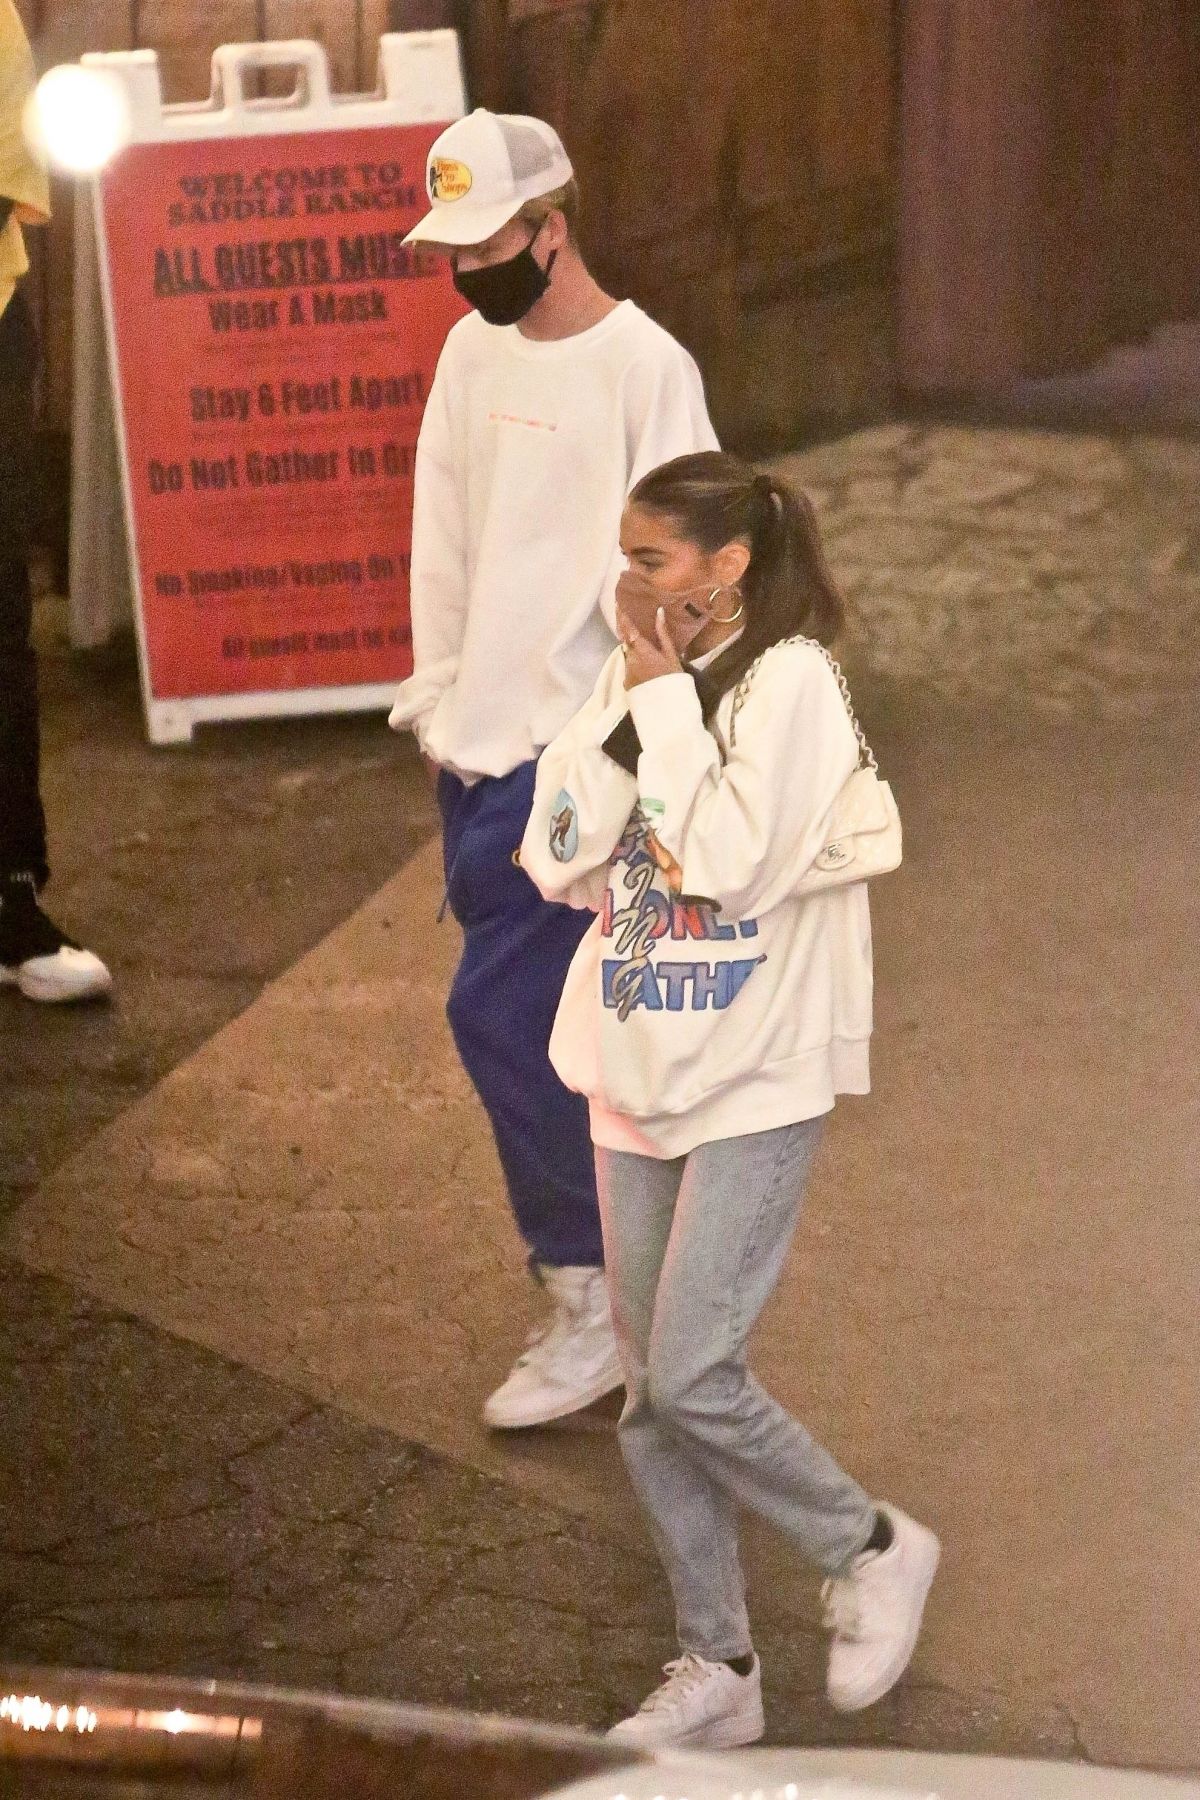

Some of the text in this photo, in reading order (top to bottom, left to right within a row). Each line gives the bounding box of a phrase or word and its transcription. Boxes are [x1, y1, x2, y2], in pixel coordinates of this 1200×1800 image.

[179, 160, 402, 197] WELCOME TO
[168, 186, 417, 227] SADDLE RANCH
[155, 244, 213, 296] ALL
[209, 288, 388, 332] Wear A Mask
[190, 369, 425, 422] Stay 6 Feet Apart
[148, 458, 183, 495] Do
[190, 452, 238, 490] Not
[245, 448, 338, 487] Gather
[348, 446, 376, 478] In
